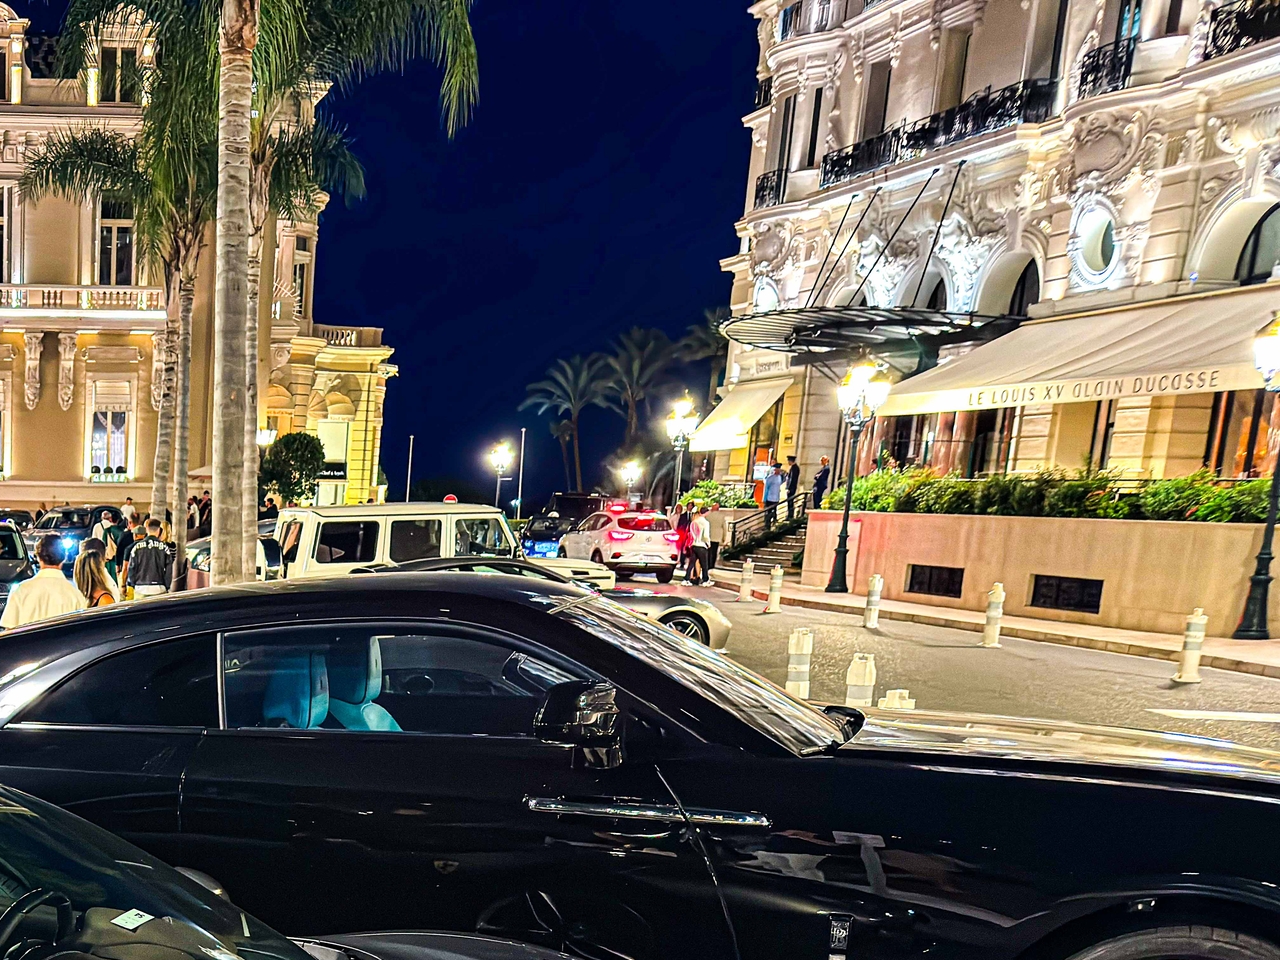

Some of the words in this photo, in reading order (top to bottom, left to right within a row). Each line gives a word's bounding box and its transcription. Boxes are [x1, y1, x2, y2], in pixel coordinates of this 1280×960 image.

[968, 392, 985, 406] LE
[991, 387, 1036, 404] LOUIS
[1043, 384, 1065, 401] XV
[1132, 370, 1221, 395] DUCASSE
